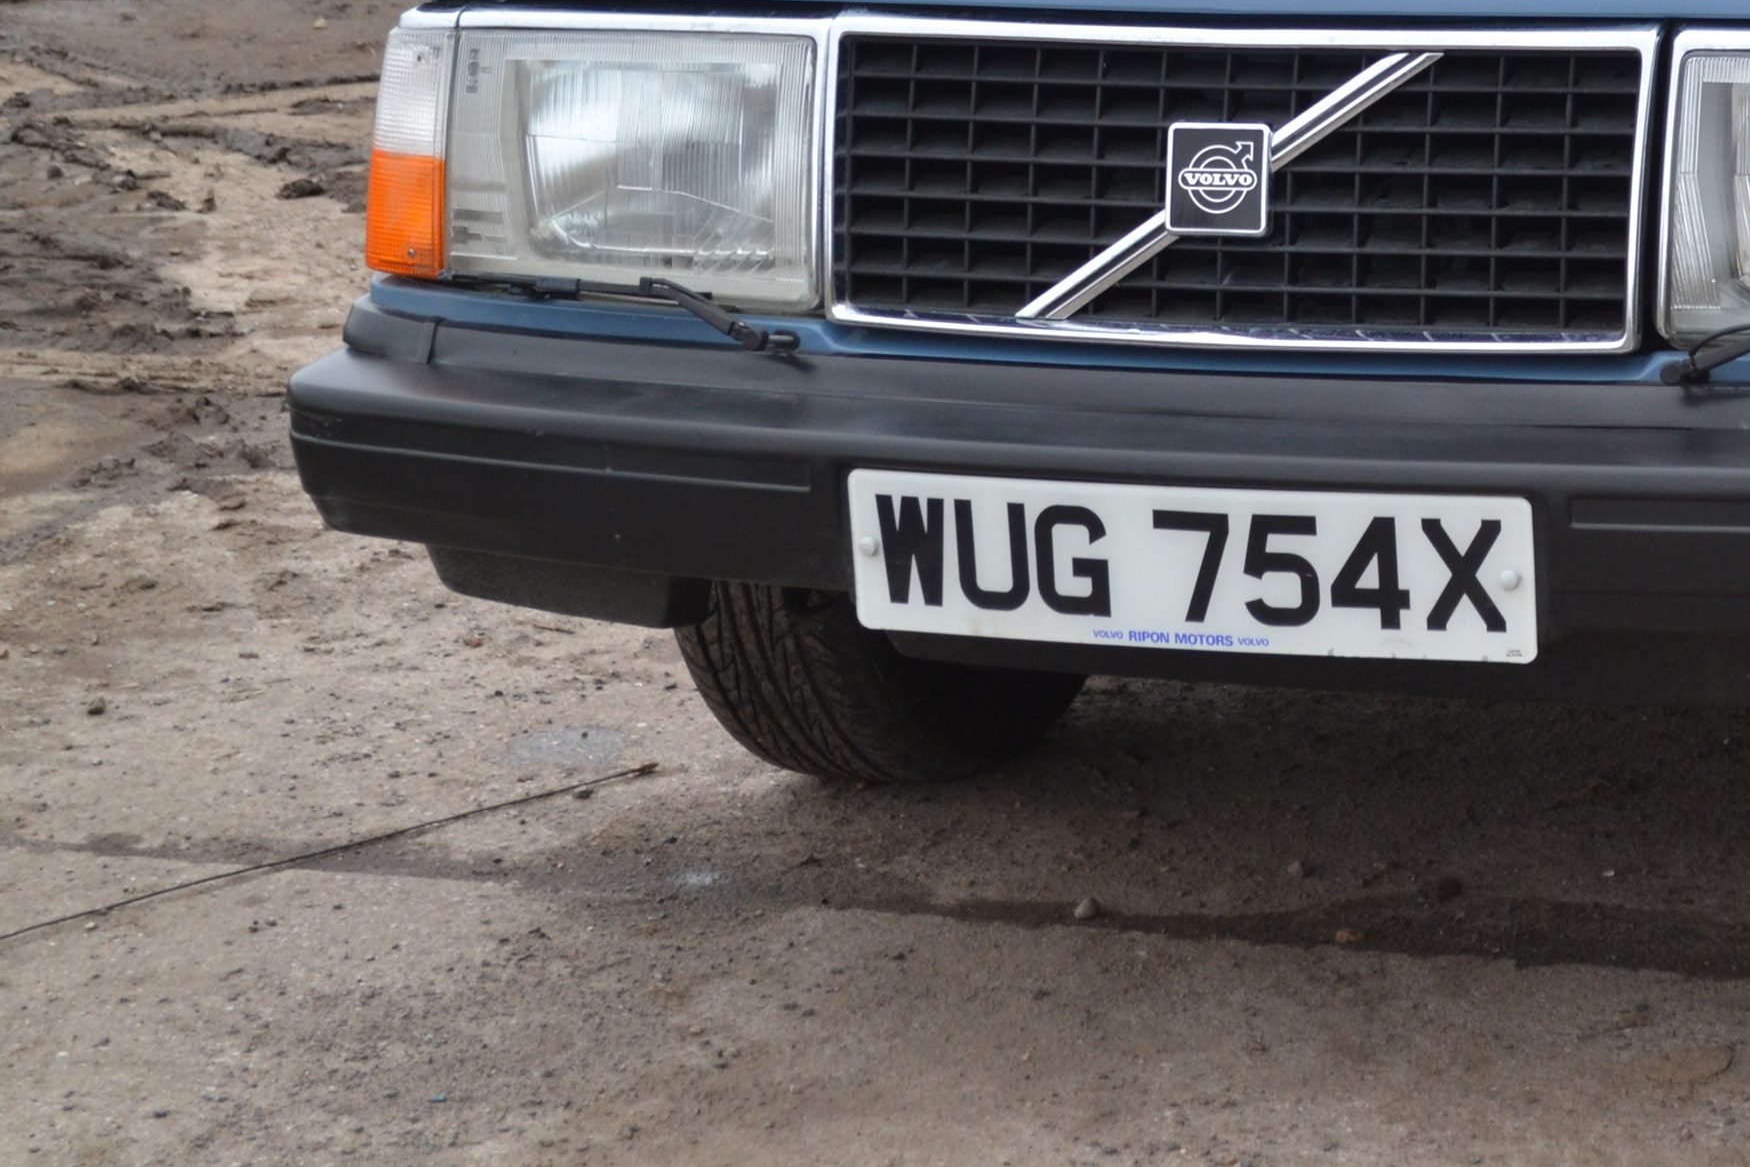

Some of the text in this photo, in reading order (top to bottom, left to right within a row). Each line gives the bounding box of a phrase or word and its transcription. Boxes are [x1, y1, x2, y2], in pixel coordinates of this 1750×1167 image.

[1183, 173, 1253, 186] VOLVO
[874, 493, 1508, 633] WUG 754X
[1093, 629, 1270, 647] VOLVO RIPON MOTORS VOLVO
